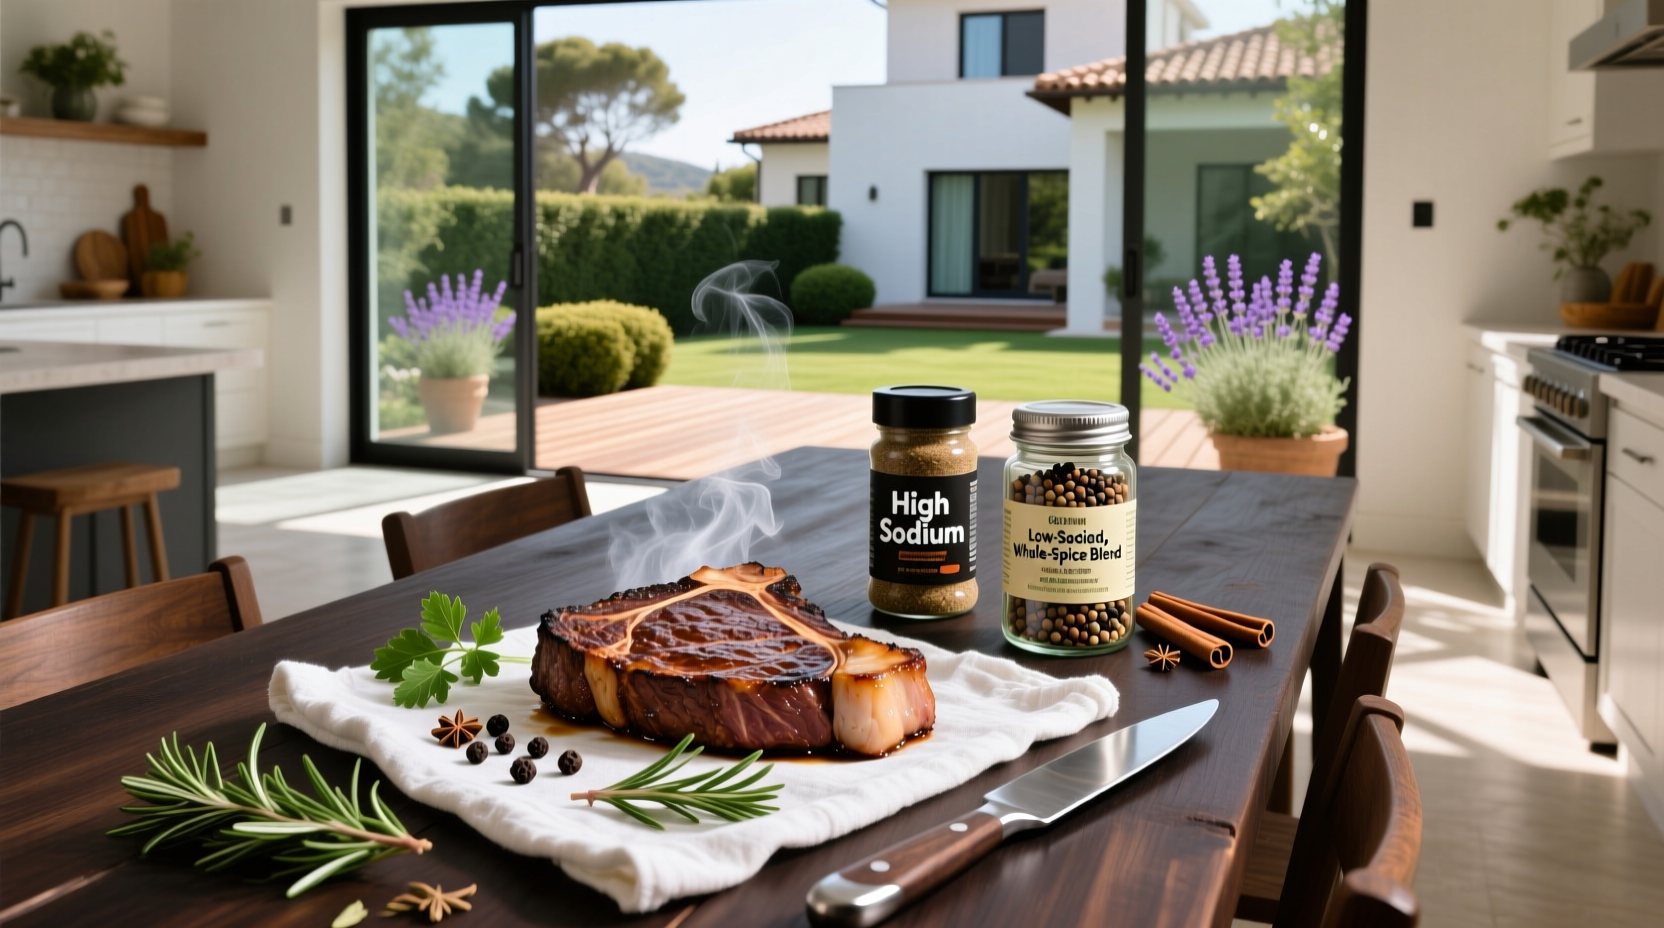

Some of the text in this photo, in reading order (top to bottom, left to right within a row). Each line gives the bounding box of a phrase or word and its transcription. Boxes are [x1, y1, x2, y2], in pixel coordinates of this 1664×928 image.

[892, 491, 949, 522] High
[880, 517, 964, 544] Sodium
[1090, 545, 1121, 561] Blend
